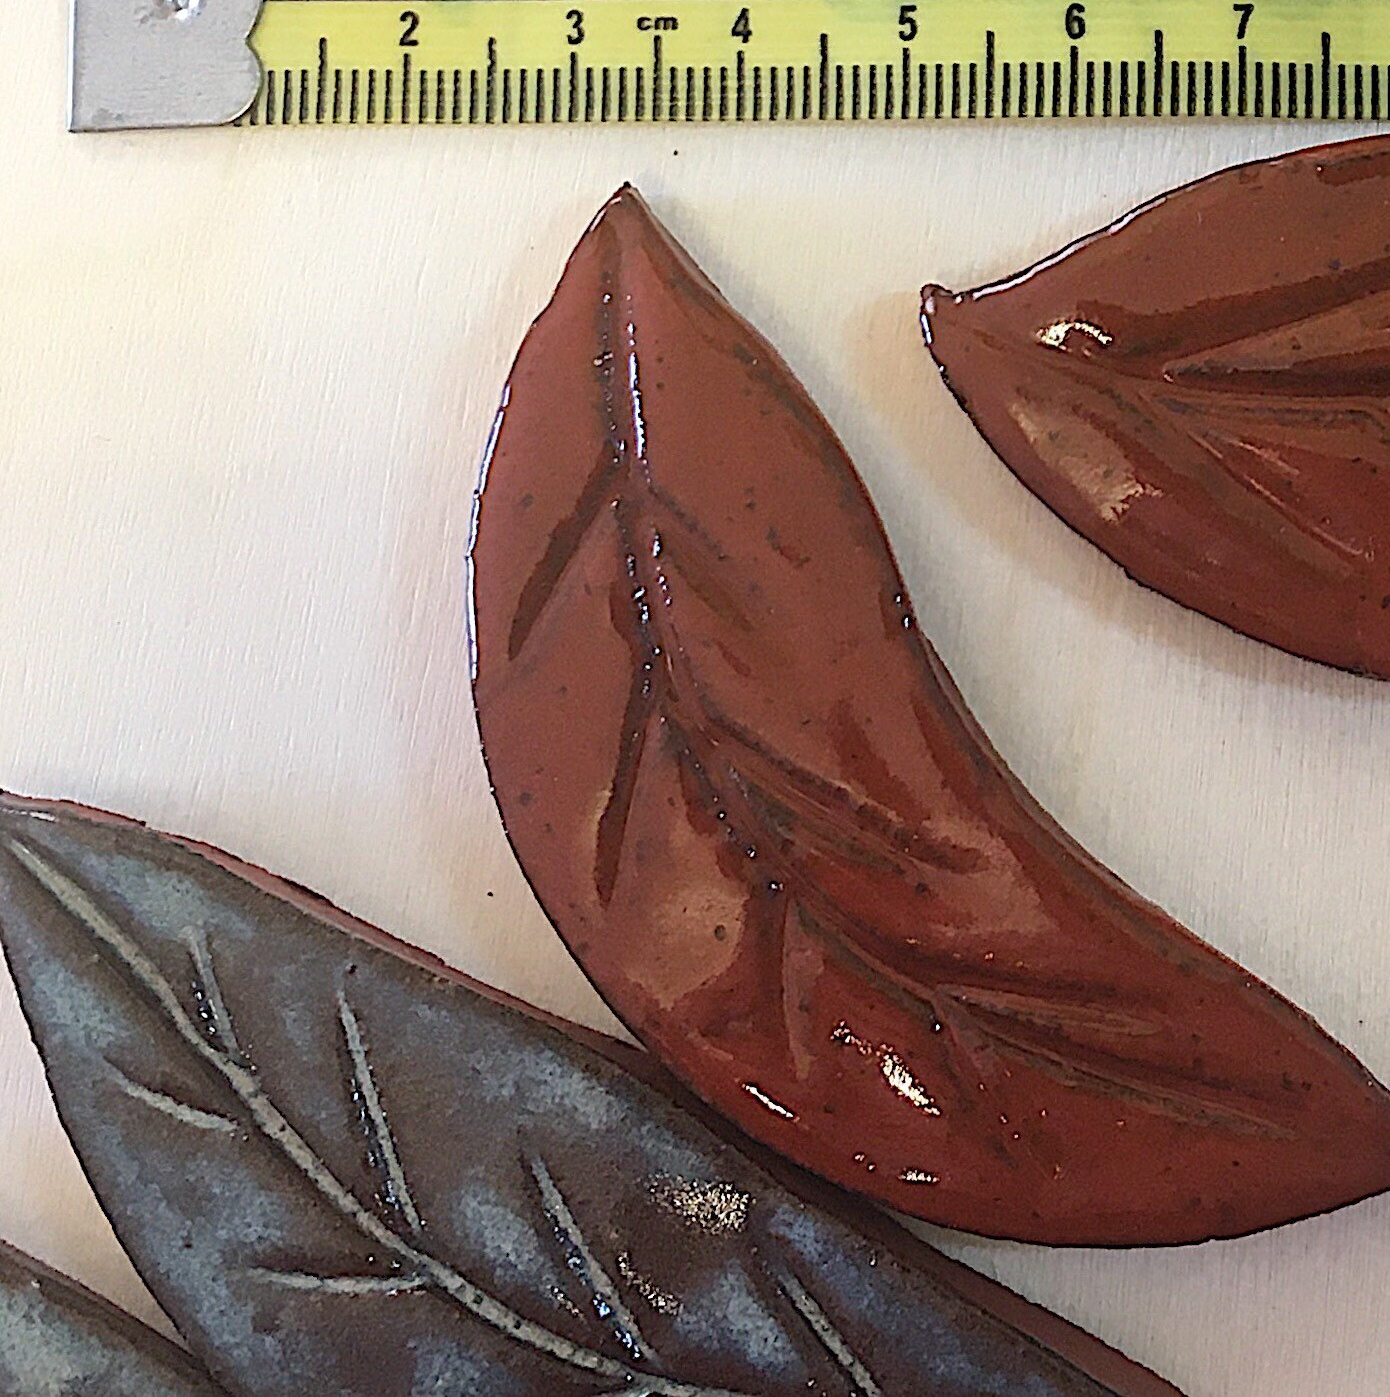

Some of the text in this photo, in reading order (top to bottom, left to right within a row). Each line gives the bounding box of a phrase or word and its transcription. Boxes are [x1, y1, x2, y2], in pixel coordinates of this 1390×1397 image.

[398, 10, 419, 47] 2
[565, 9, 585, 45] 3
[636, 16, 679, 31] cm
[731, 7, 753, 44] 4
[898, 4, 918, 42] 5
[1064, 2, 1086, 40] 6
[1232, 3, 1255, 40] 7
